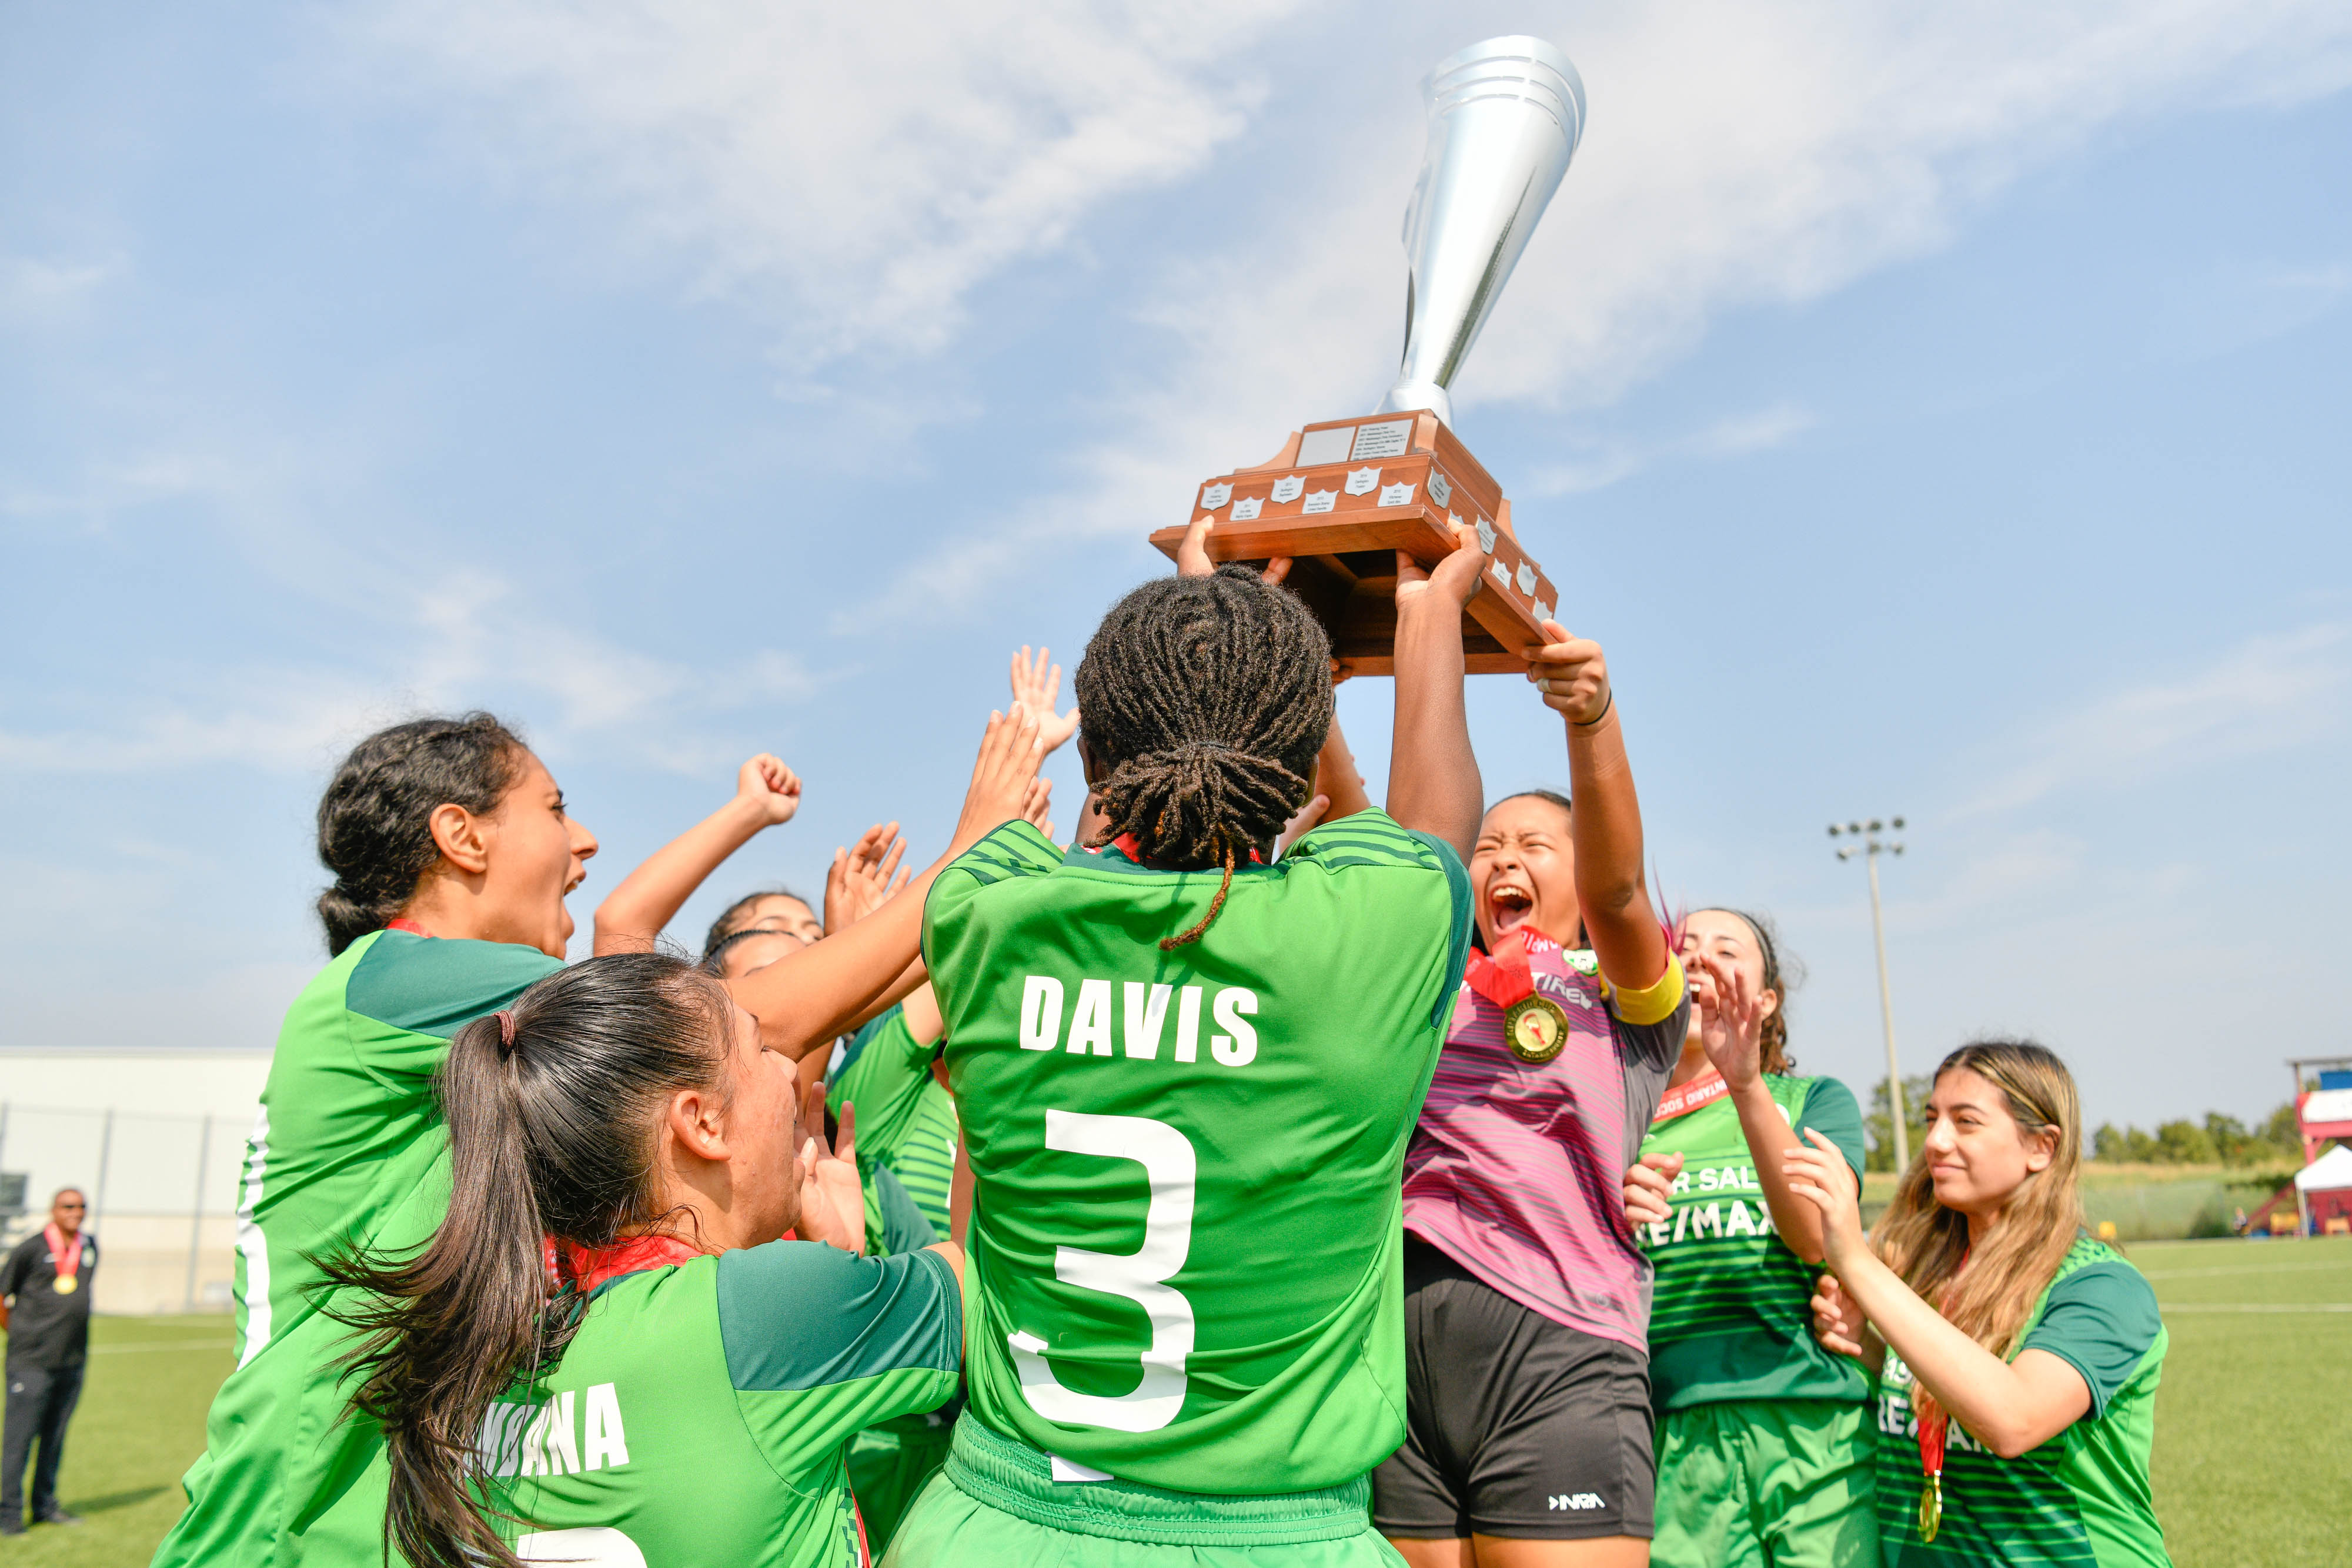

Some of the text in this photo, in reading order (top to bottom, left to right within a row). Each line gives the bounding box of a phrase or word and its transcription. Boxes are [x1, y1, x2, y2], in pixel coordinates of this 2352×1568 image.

[1019, 976, 1258, 1067] DAVIS
[1007, 1109, 1197, 1433] 3
[463, 1382, 630, 1477] MBANA
